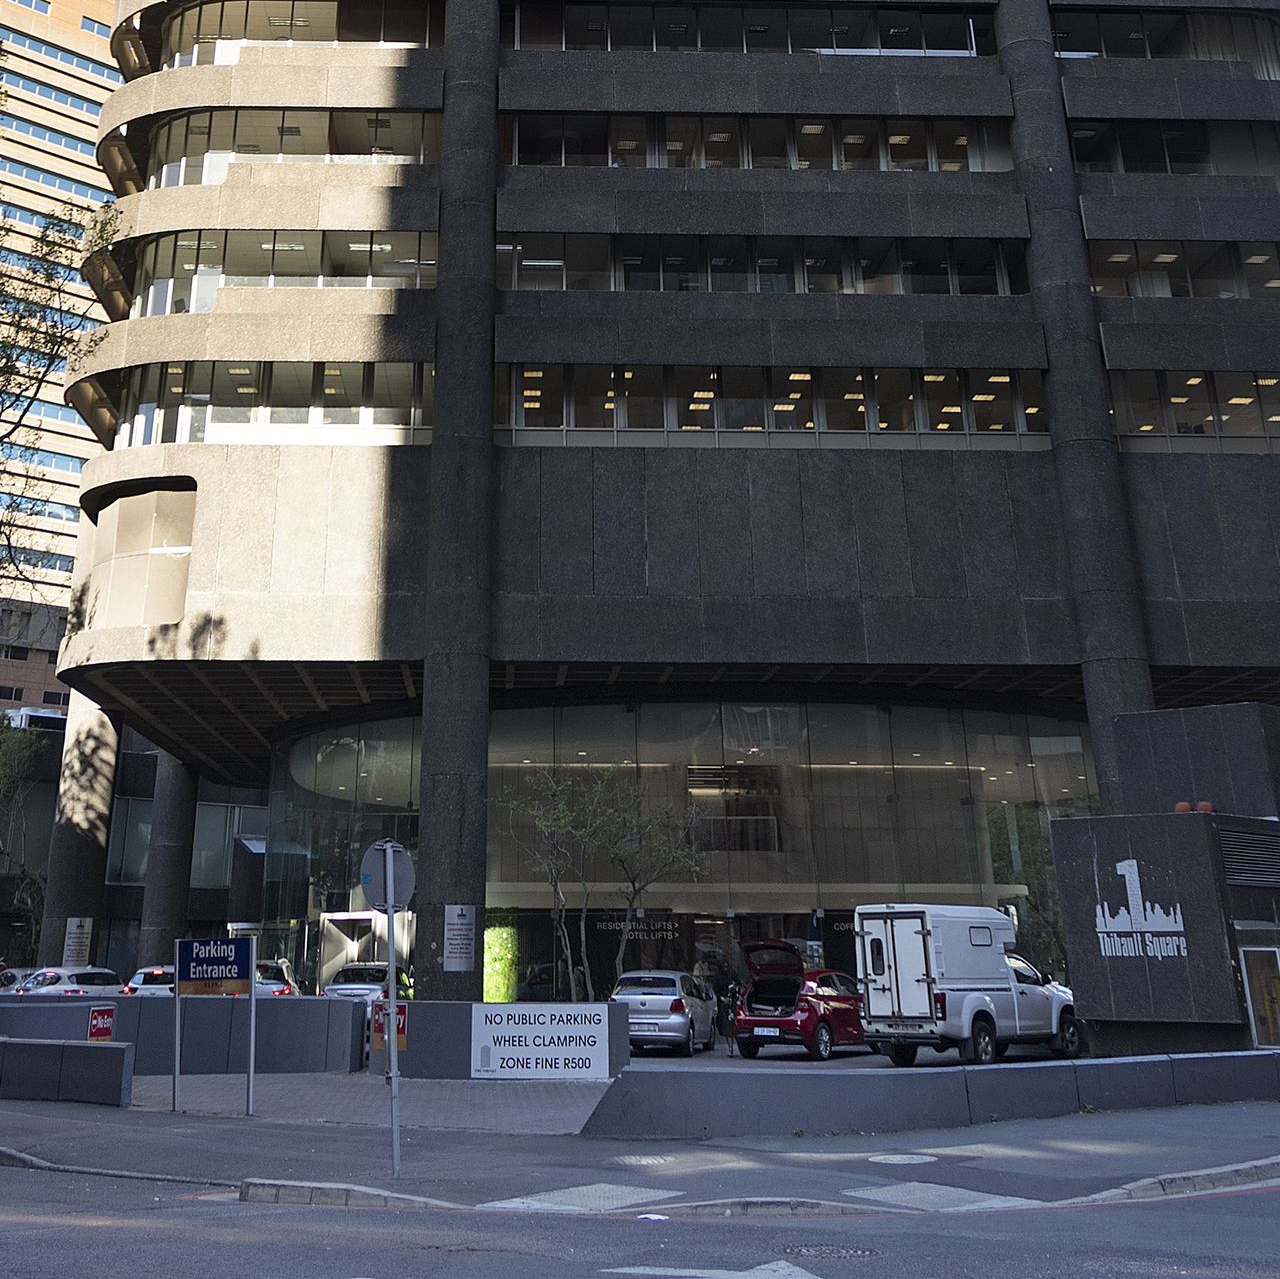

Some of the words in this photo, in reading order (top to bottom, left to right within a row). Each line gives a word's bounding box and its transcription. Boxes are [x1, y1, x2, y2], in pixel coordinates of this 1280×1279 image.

[650, 922, 673, 930] LIFTS
[650, 932, 673, 940] LIFTS
[193, 941, 235, 961] Parking
[1098, 933, 1144, 957] Thibault
[1145, 933, 1188, 961] Square
[190, 962, 238, 978] Entrance
[485, 1014, 503, 1025] NO
[507, 1014, 546, 1025] PUBLIC
[550, 1014, 602, 1025] PARKING
[492, 1035, 529, 1047] WHEEL
[533, 1035, 597, 1047] CLAMPING
[500, 1057, 531, 1069] ZONE
[535, 1057, 560, 1069] FINE
[564, 1057, 591, 1069] R500
